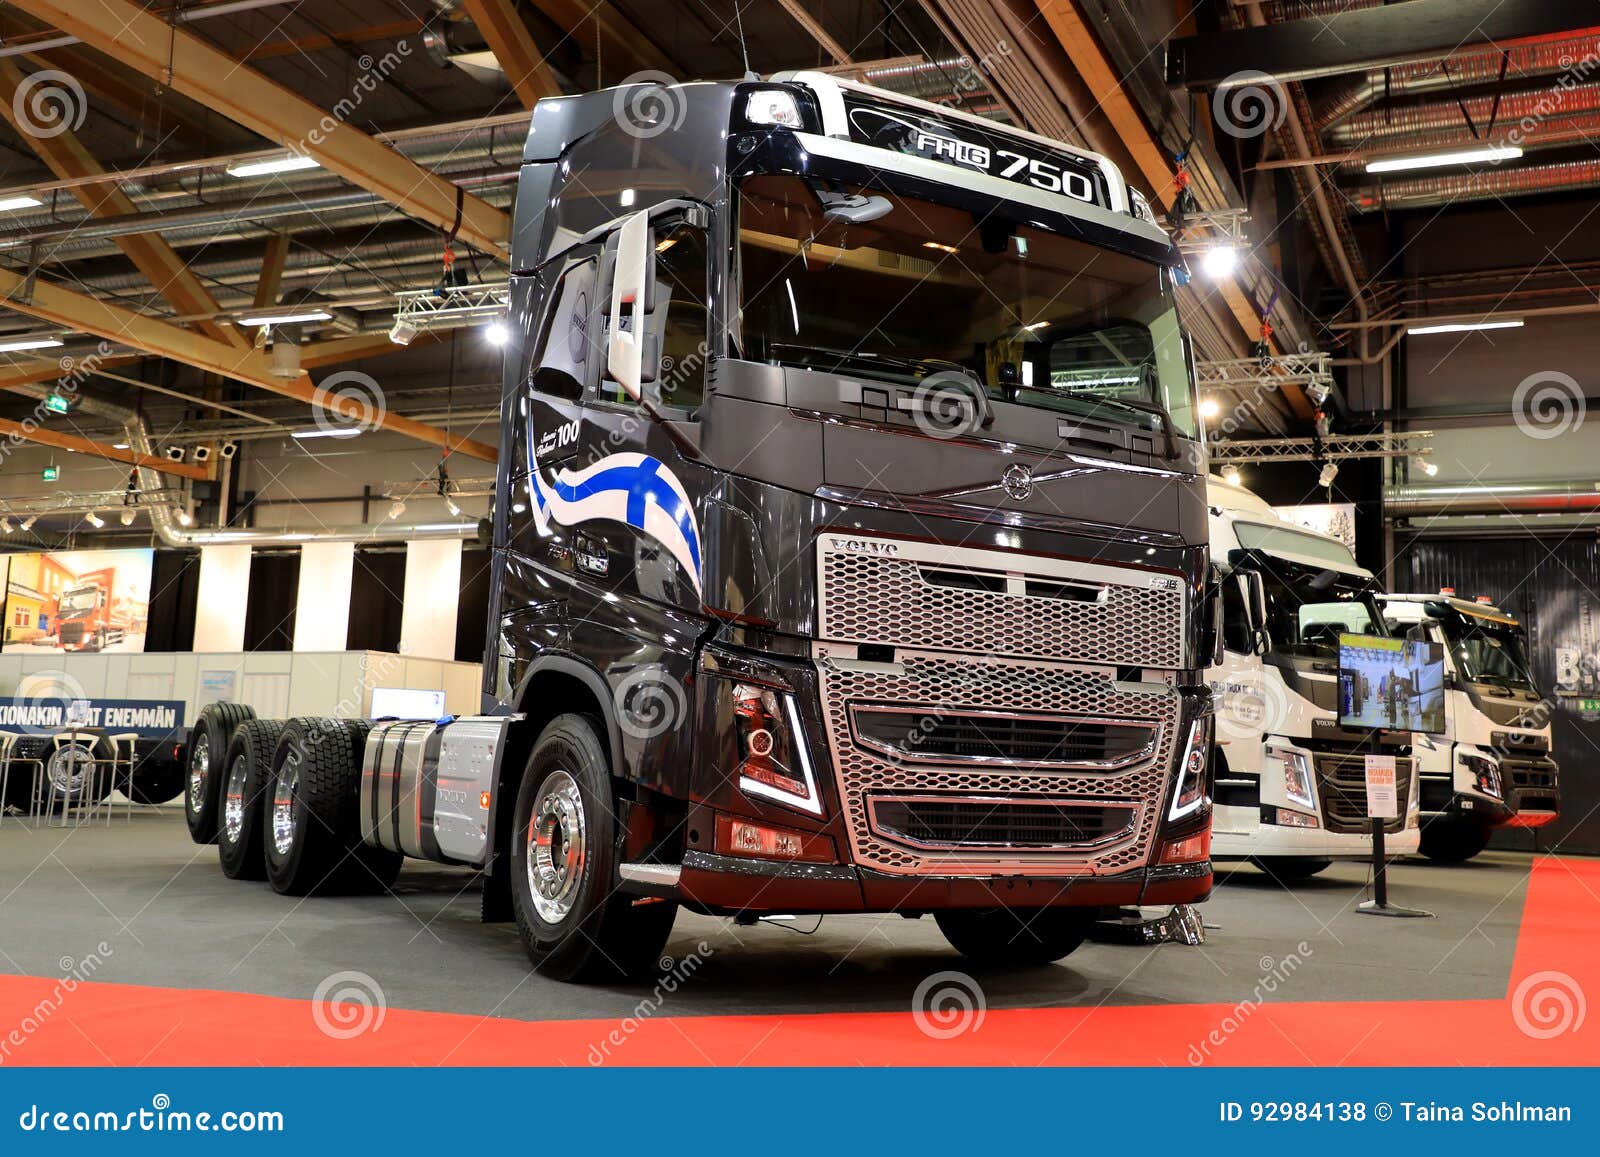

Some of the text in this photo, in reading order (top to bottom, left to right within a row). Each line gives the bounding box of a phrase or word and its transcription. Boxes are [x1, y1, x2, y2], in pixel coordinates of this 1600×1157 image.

[996, 149, 1093, 202] 750
[558, 420, 580, 447] 100
[829, 538, 898, 555] VOLVO
[104, 705, 176, 729] ENEMMÄN
